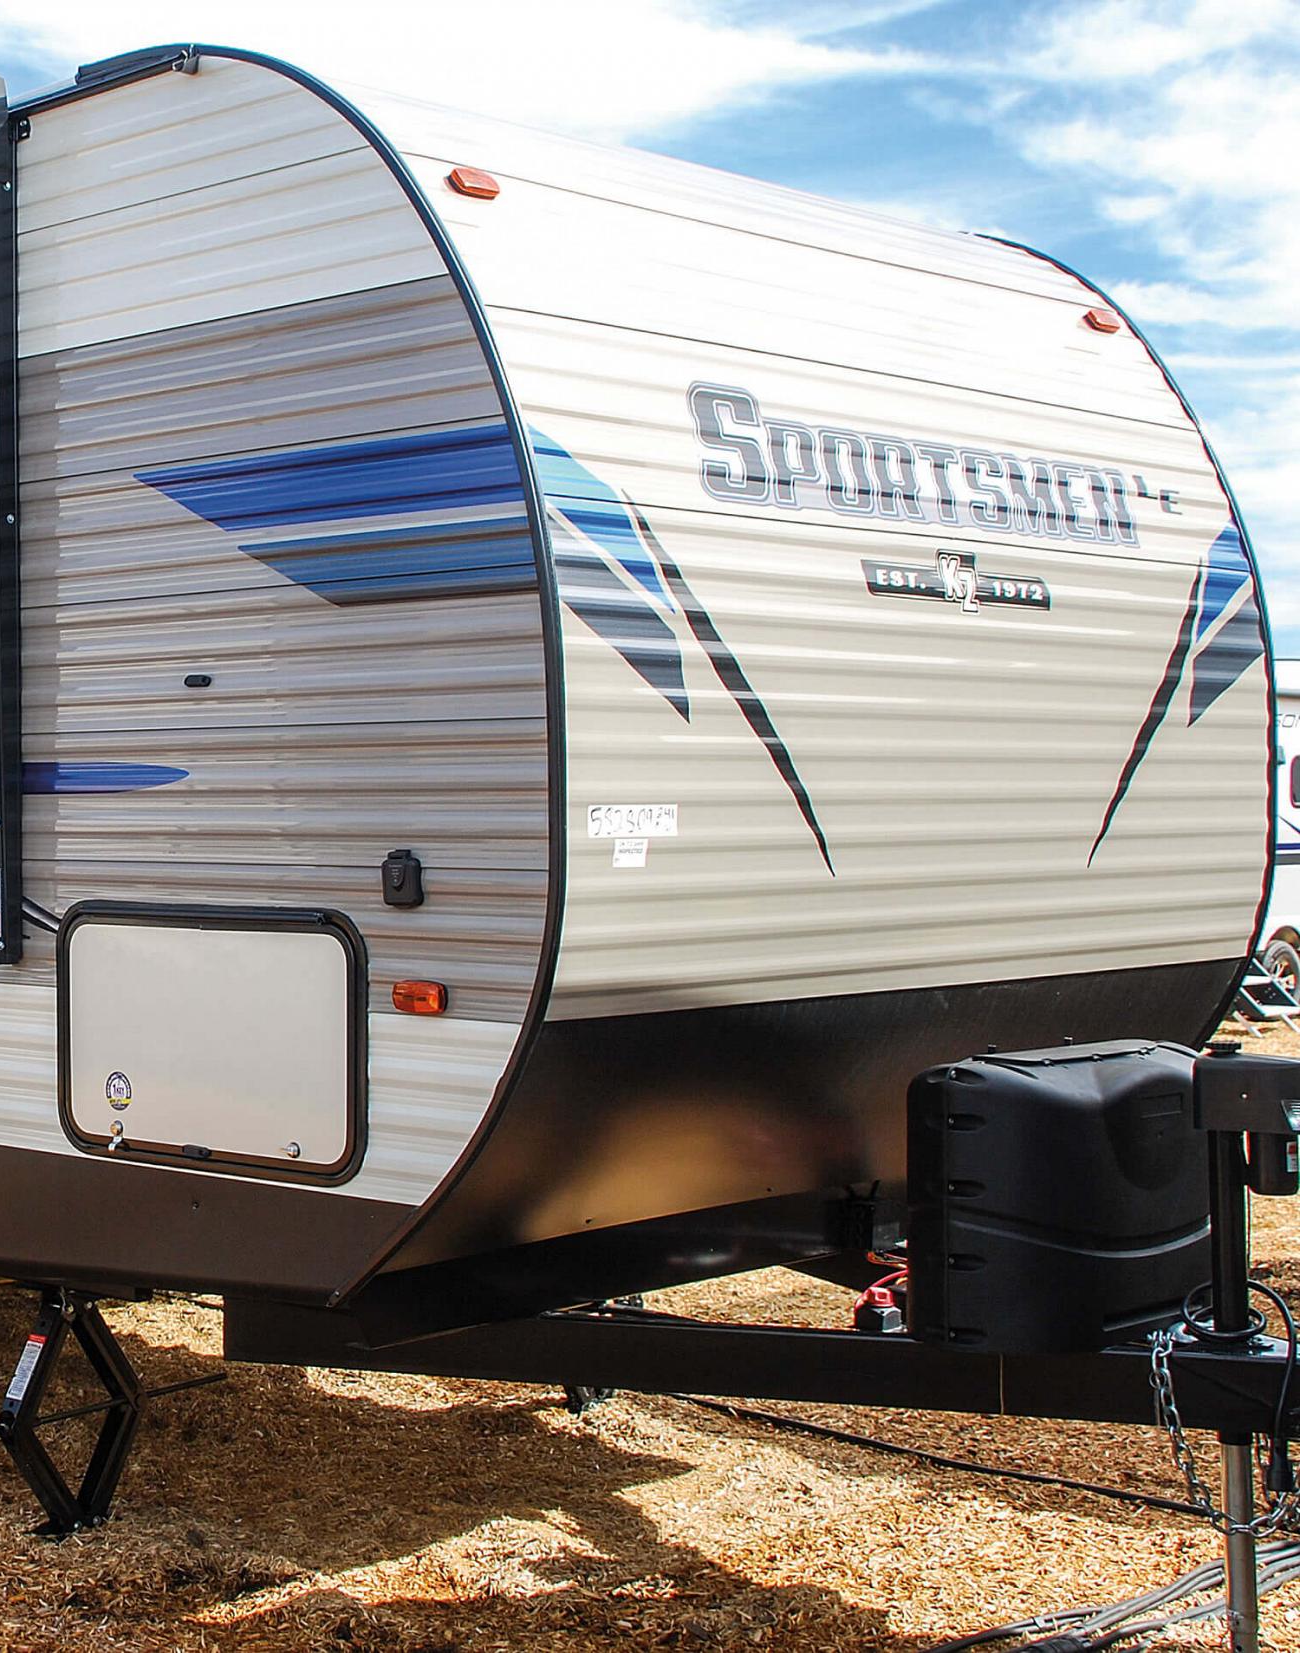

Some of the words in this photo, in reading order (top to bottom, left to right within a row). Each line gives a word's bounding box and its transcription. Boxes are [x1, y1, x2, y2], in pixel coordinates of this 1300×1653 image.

[686, 380, 1140, 547] SPORTSMEN
[875, 568, 927, 590] EST.
[937, 552, 979, 614] KZ
[991, 579, 1045, 601] 1972
